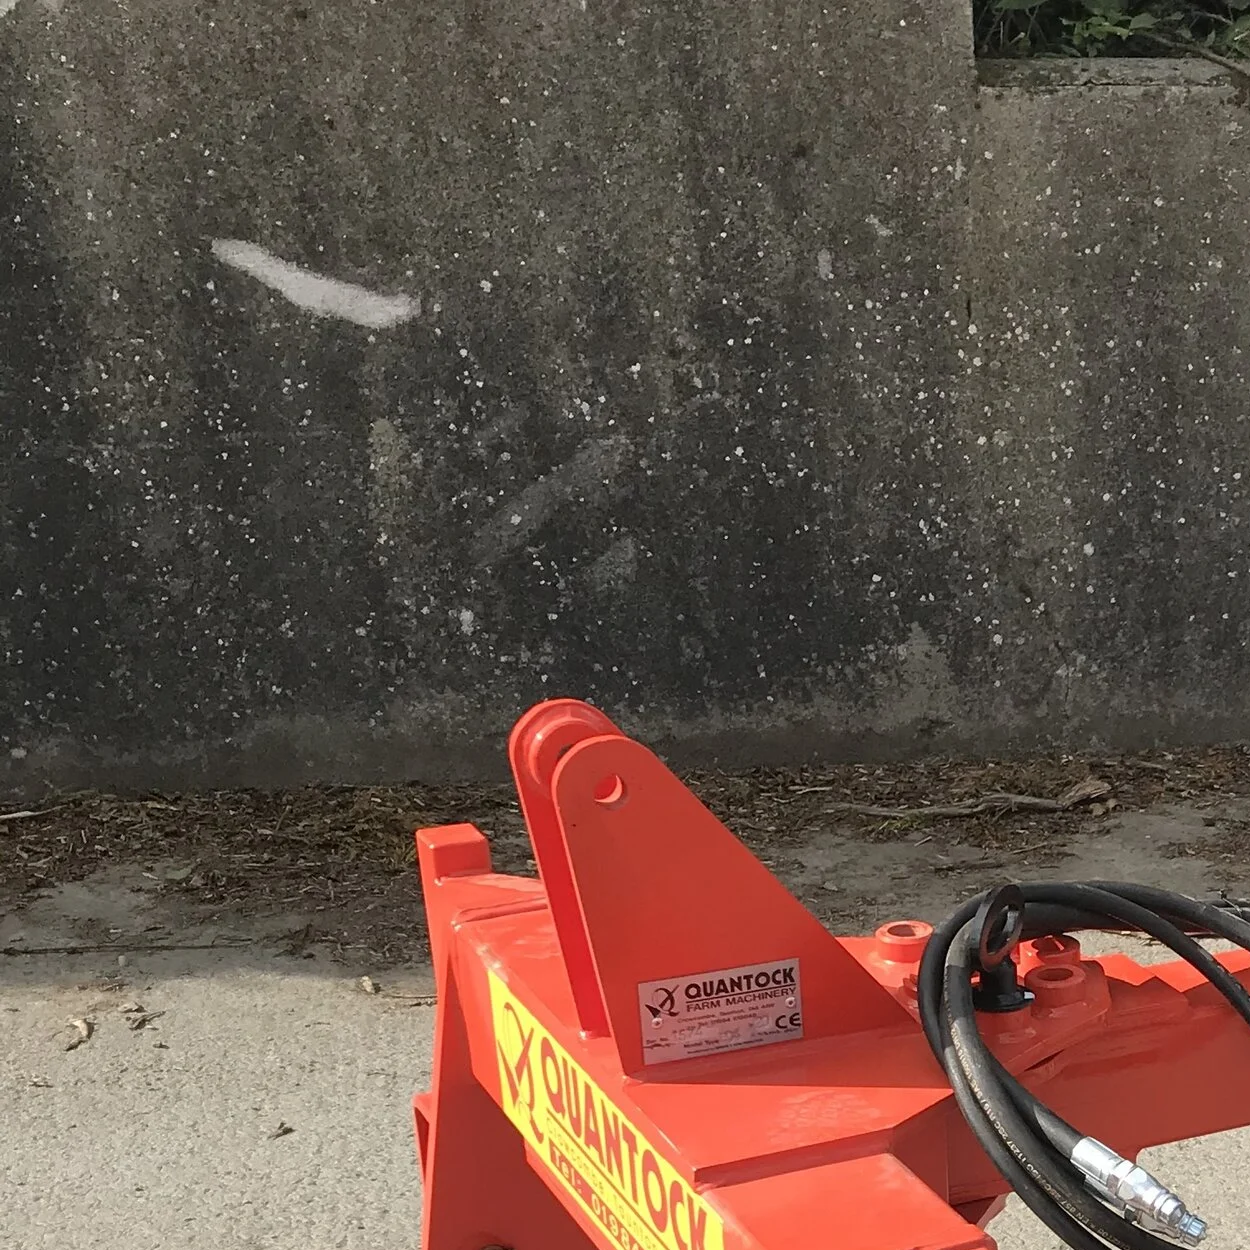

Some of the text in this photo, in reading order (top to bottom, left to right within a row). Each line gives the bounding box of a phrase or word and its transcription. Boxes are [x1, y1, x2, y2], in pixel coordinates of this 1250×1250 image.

[685, 967, 795, 999] QUANTOCK
[686, 987, 796, 1012] FARM MACHINERY
